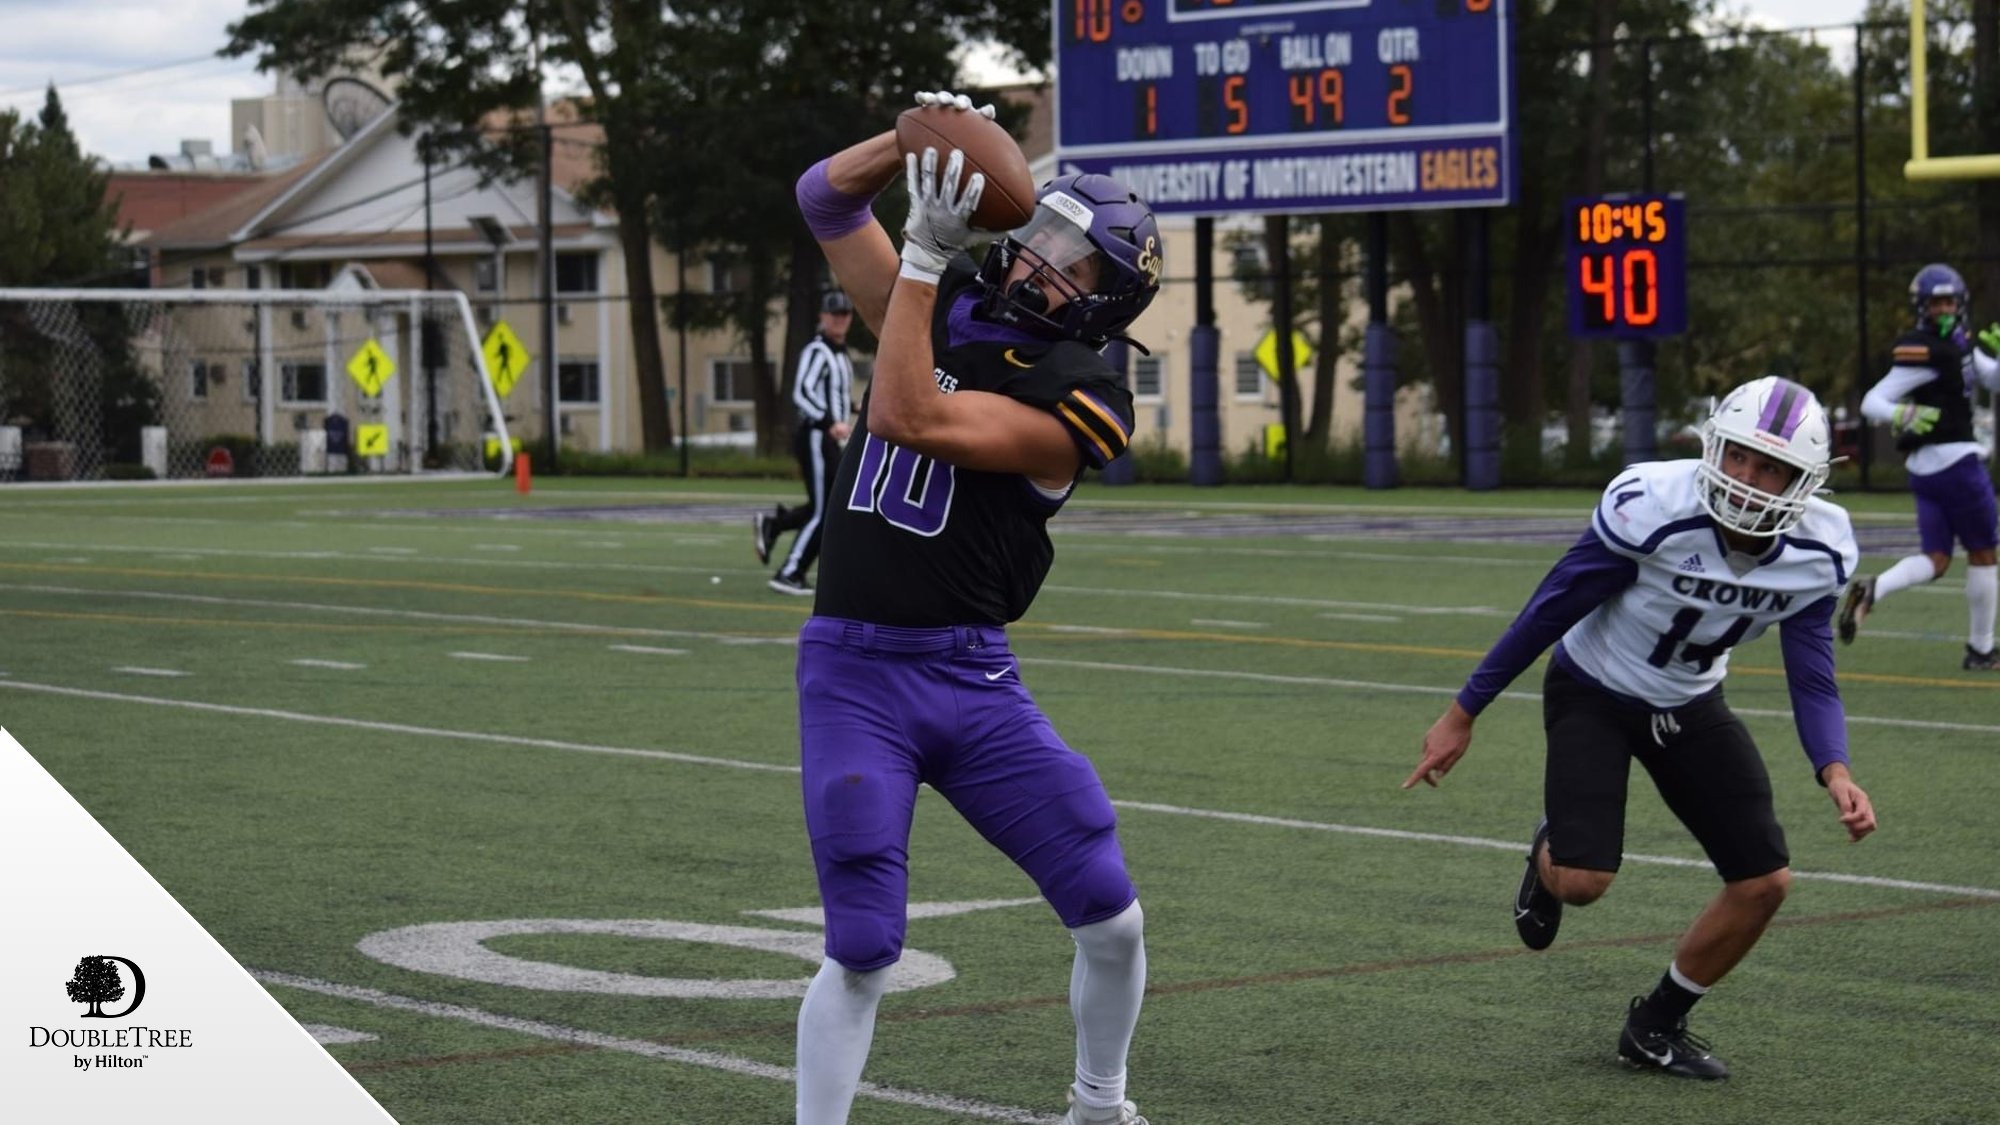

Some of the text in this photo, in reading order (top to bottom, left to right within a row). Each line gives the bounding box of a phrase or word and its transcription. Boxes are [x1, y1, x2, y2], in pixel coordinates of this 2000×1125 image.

[1117, 46, 1173, 82] DOWN
[1194, 38, 1250, 76] TO GO
[1280, 31, 1352, 70] BALL ON
[1378, 27, 1419, 64] QTR
[1147, 85, 1157, 134] 1
[1224, 76, 1248, 133] 5
[1289, 69, 1343, 124] 49
[1387, 65, 1412, 124] 2
[1224, 159, 1249, 201] OF
[1253, 152, 1416, 199] NORTHWESTERN
[1421, 147, 1497, 191] EAGLES
[1580, 201, 1666, 243] 10:45
[1581, 250, 1657, 324] 40
[1672, 575, 1794, 612] CROWN
[1648, 607, 1753, 675] 14
